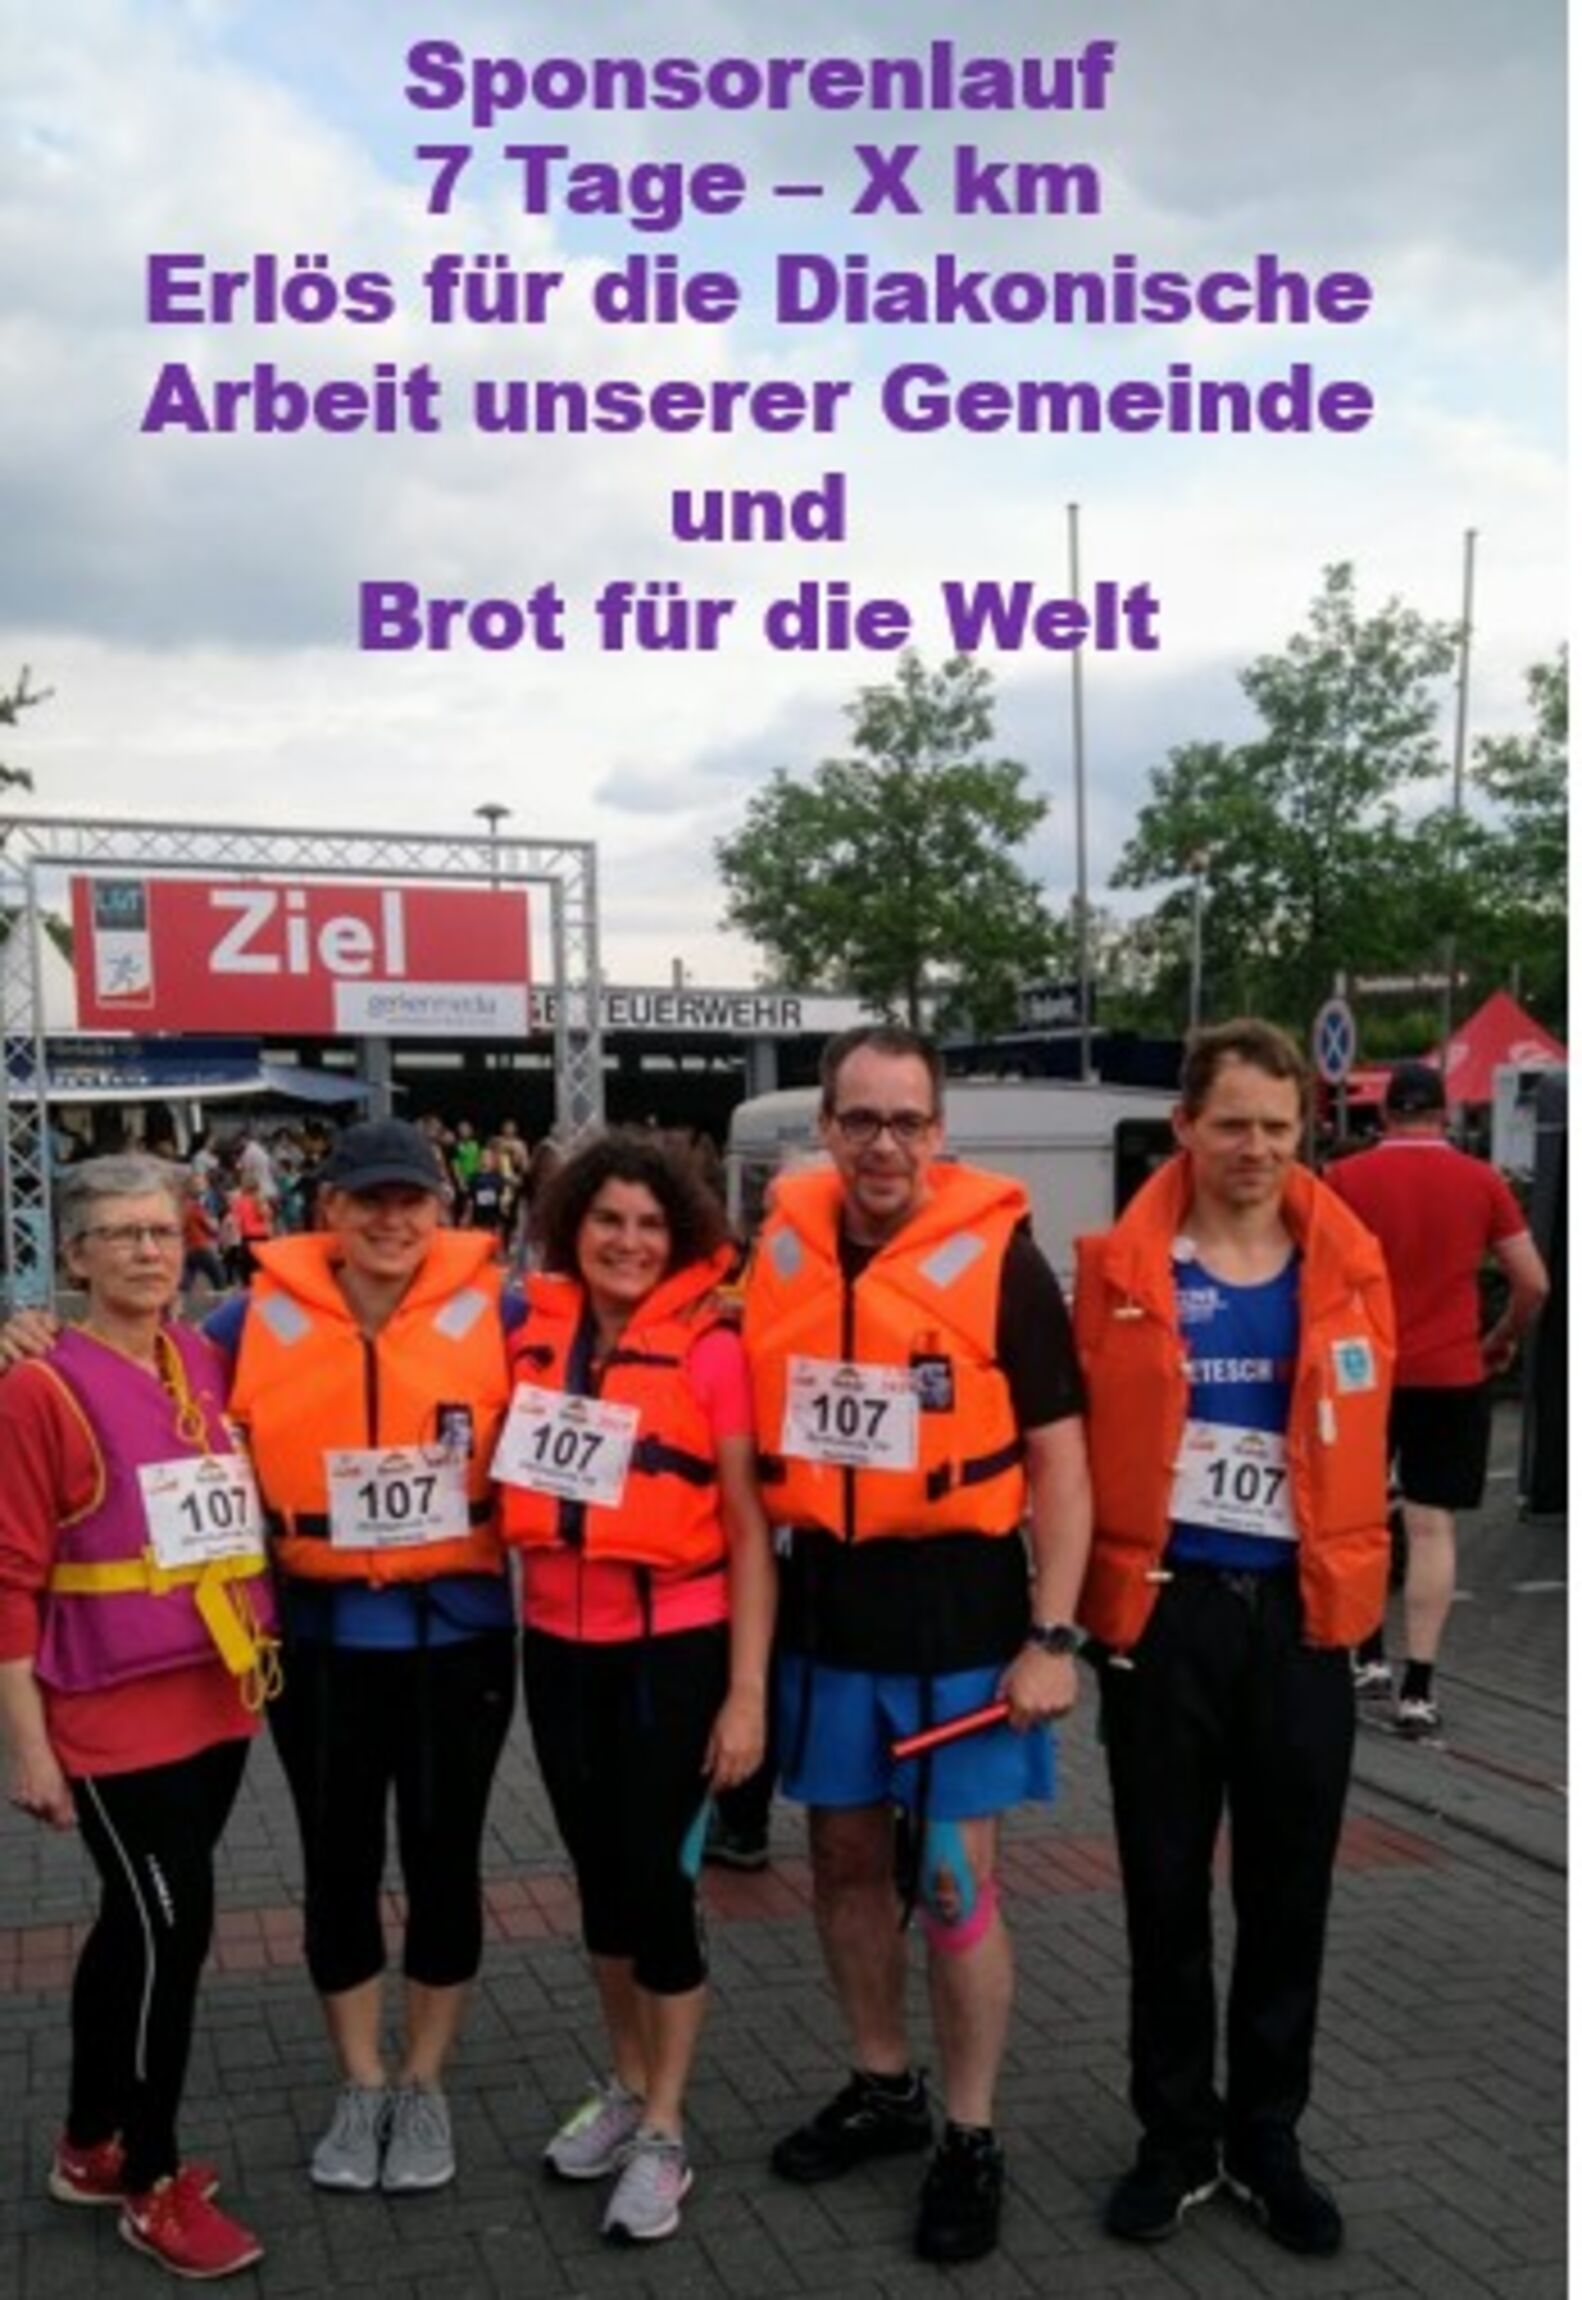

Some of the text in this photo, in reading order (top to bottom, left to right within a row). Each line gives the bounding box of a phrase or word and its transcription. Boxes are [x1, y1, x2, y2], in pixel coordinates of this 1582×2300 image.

[208, 889, 405, 975] Ziel
[602, 994, 802, 1027] EUERWEHR
[1187, 1357, 1275, 1382] ETESCH
[812, 1393, 889, 1438] 107
[532, 1423, 604, 1471] 107
[358, 1473, 437, 1519] 107
[1208, 1458, 1287, 1505] 107
[180, 1486, 247, 1533] 107
